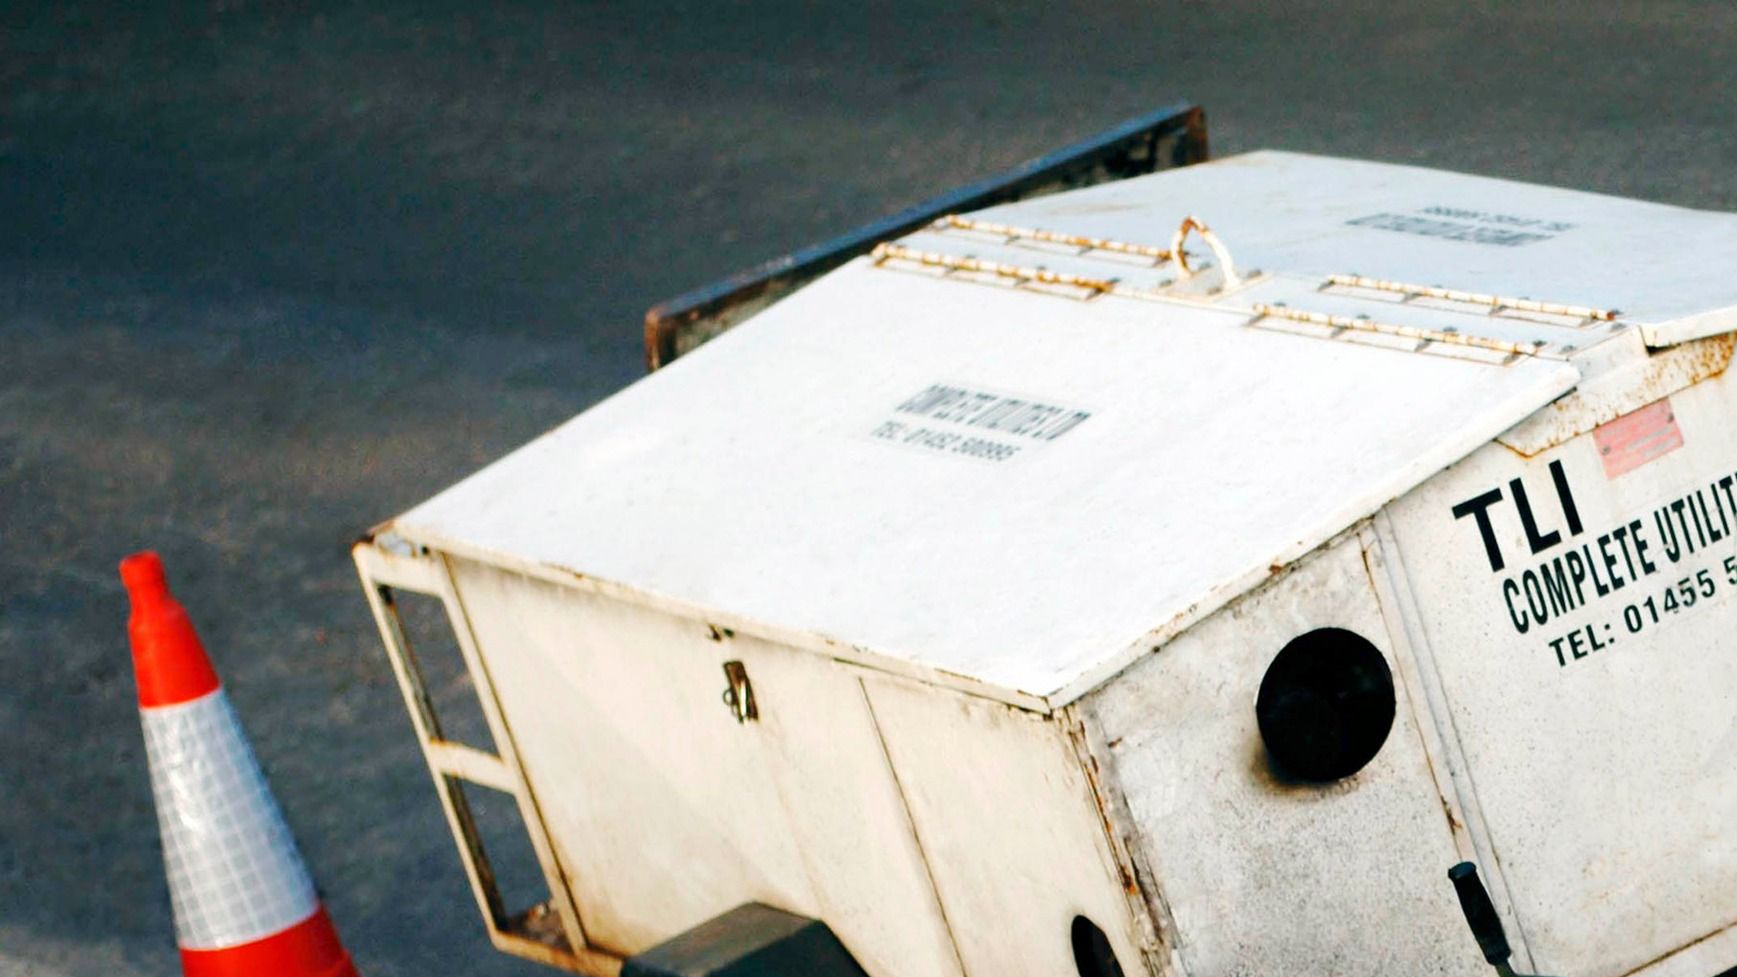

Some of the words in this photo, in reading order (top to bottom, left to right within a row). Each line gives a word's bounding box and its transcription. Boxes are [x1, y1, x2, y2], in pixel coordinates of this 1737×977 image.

[1451, 459, 1584, 573] TLI
[1502, 519, 1657, 635] COMPLETE
[1548, 623, 1616, 667] TEL:
[1623, 568, 1716, 634] 01455
